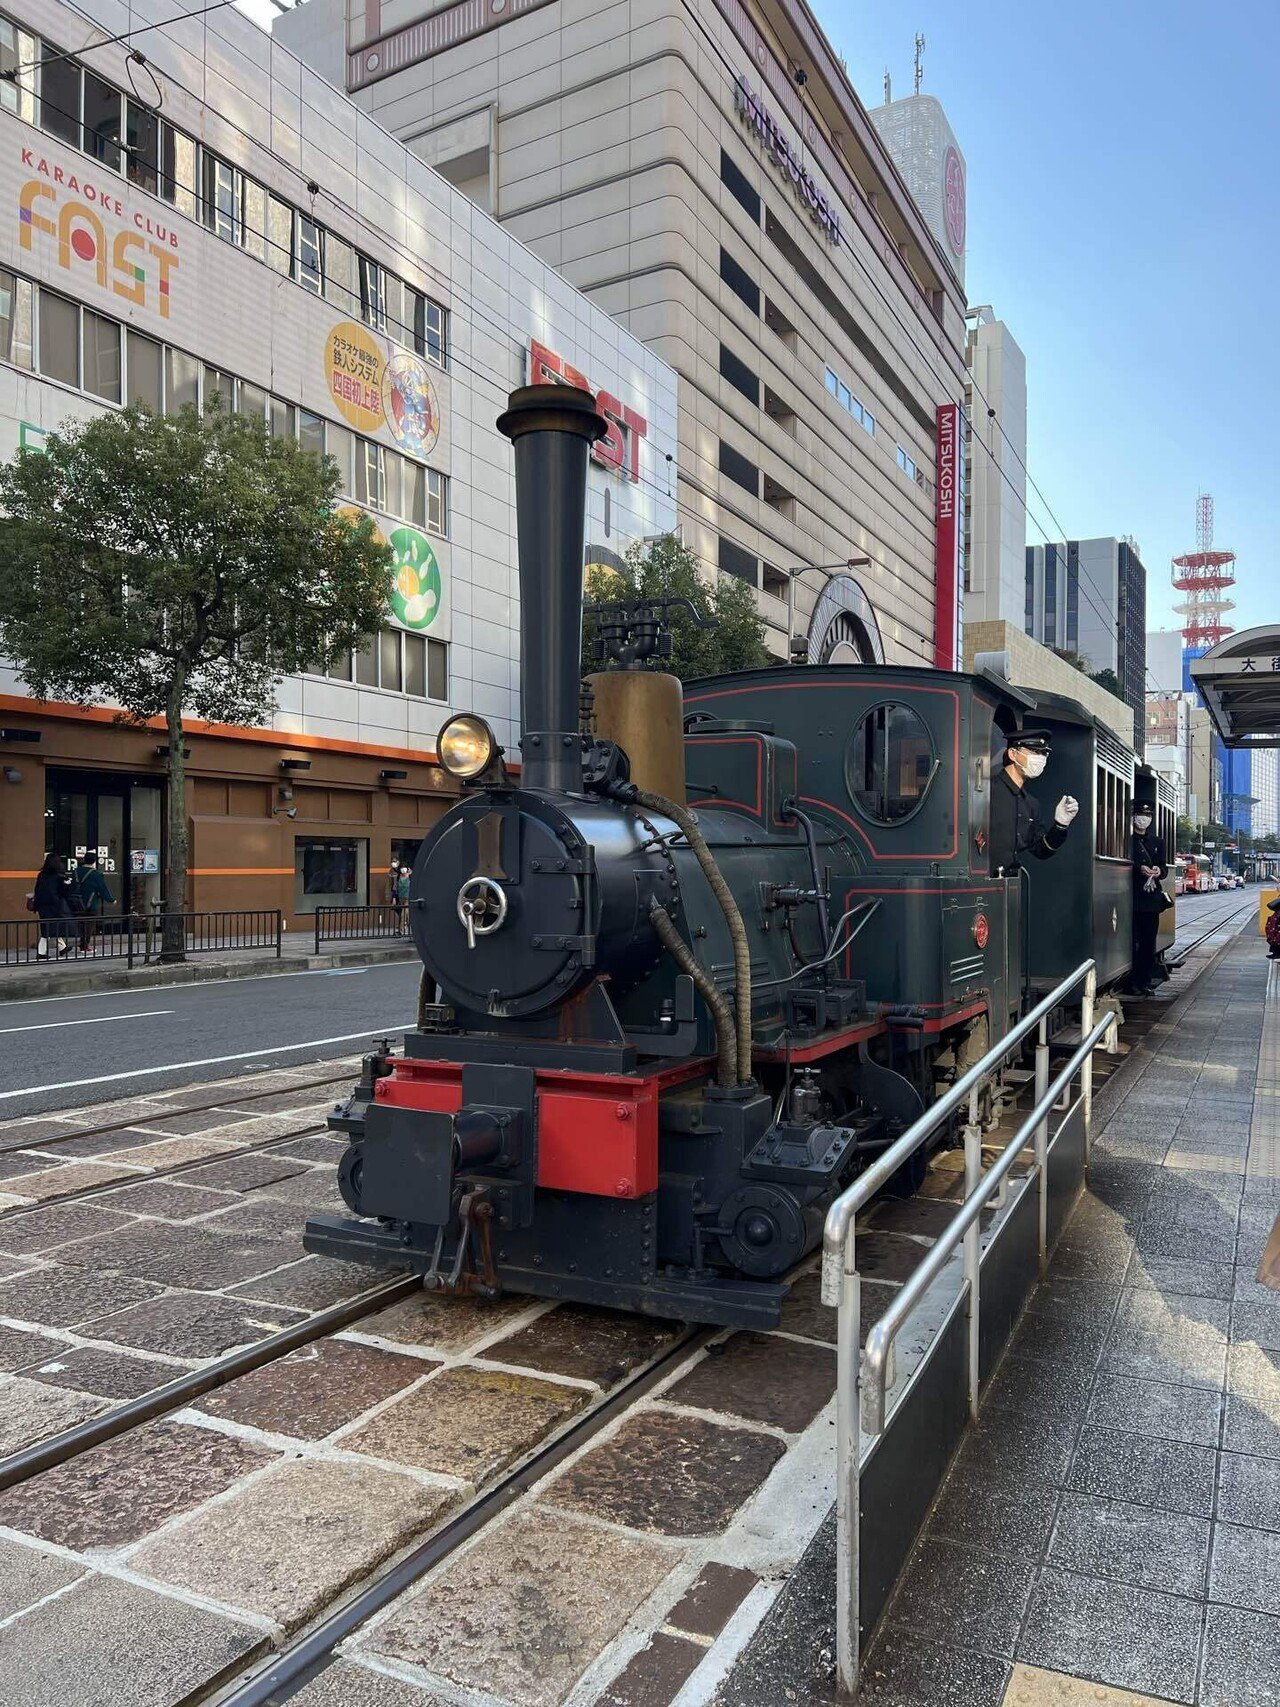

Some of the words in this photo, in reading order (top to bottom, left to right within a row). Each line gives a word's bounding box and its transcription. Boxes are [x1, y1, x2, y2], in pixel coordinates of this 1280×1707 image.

[20, 180, 179, 319] FAST
[22, 148, 122, 216] KARAOKE
[134, 212, 178, 248] CLUB
[332, 369, 380, 415] 四国初上陸
[333, 348, 379, 386] 鉄人システム
[530, 337, 647, 484] FST
[940, 412, 953, 518] MITSUKOSHI
